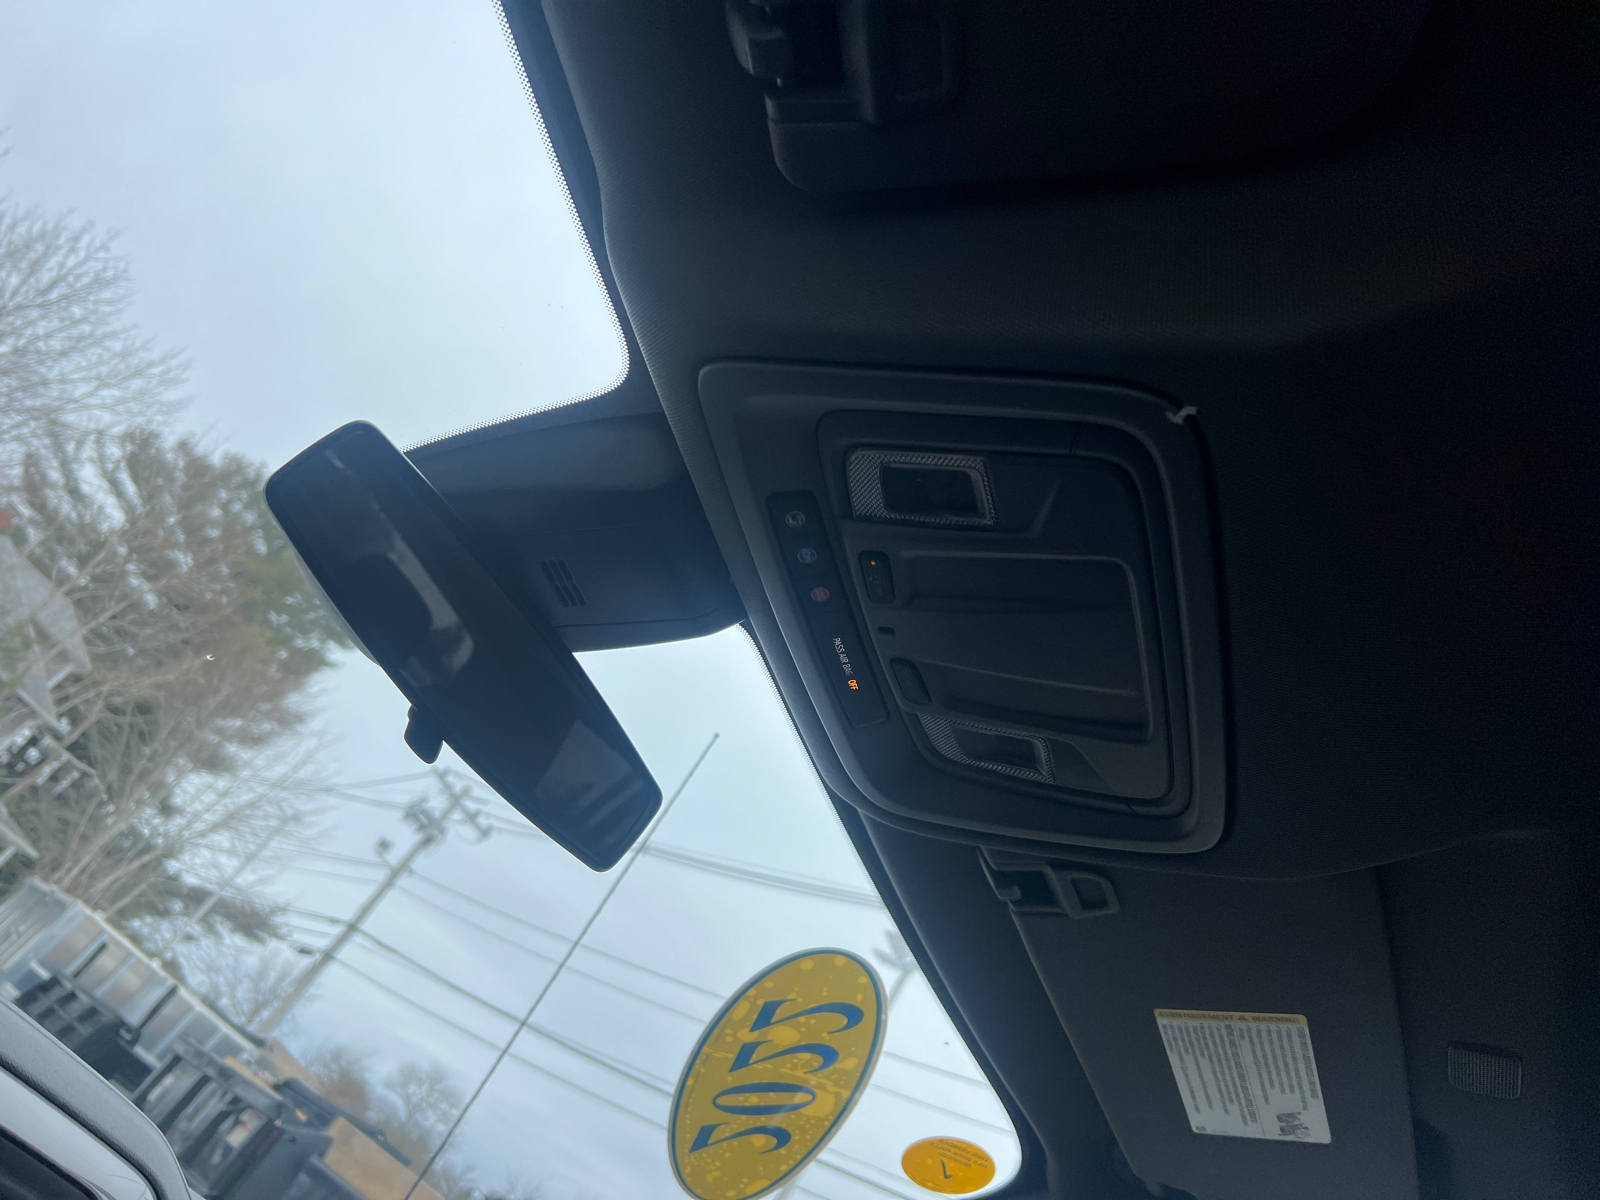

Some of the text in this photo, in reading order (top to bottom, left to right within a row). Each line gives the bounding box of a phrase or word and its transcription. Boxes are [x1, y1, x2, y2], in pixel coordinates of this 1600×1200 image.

[832, 637, 845, 653] PASS
[838, 653, 849, 664] AIR
[847, 679, 859, 690] OFF
[1251, 1015, 1300, 1024] WARNING
